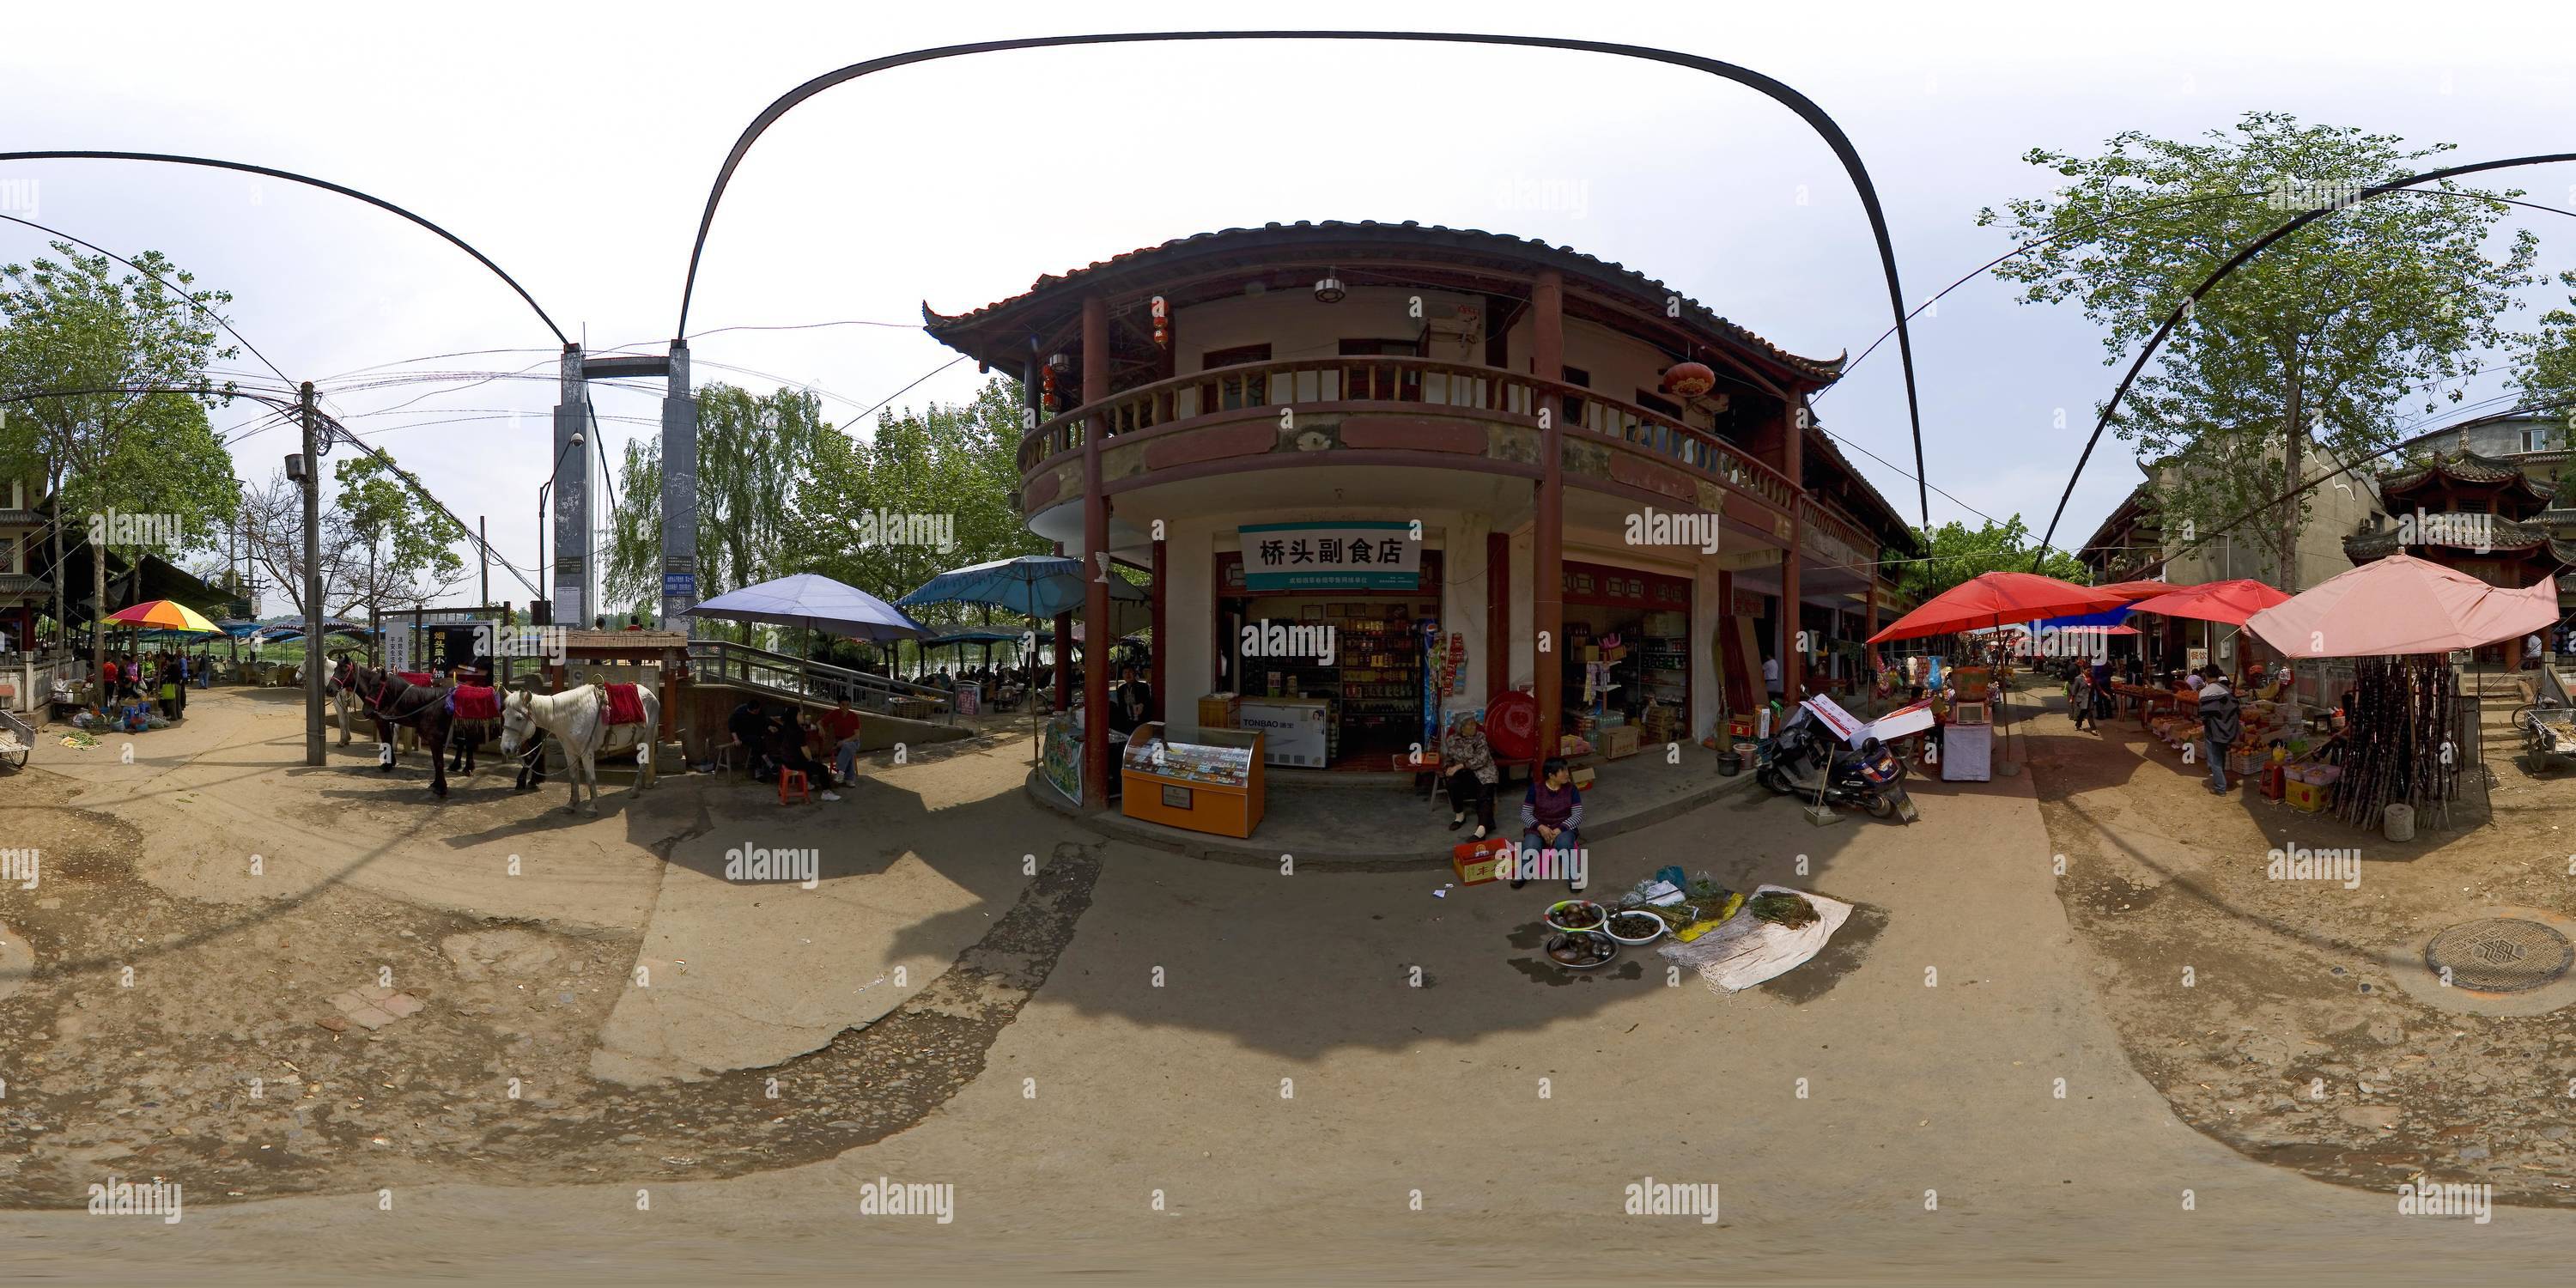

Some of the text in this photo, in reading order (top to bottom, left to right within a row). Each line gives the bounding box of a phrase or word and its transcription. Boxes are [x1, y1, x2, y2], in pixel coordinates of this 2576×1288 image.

[1260, 538, 1403, 565] 桥头副食店
[1243, 719, 1279, 728] TONBAO
